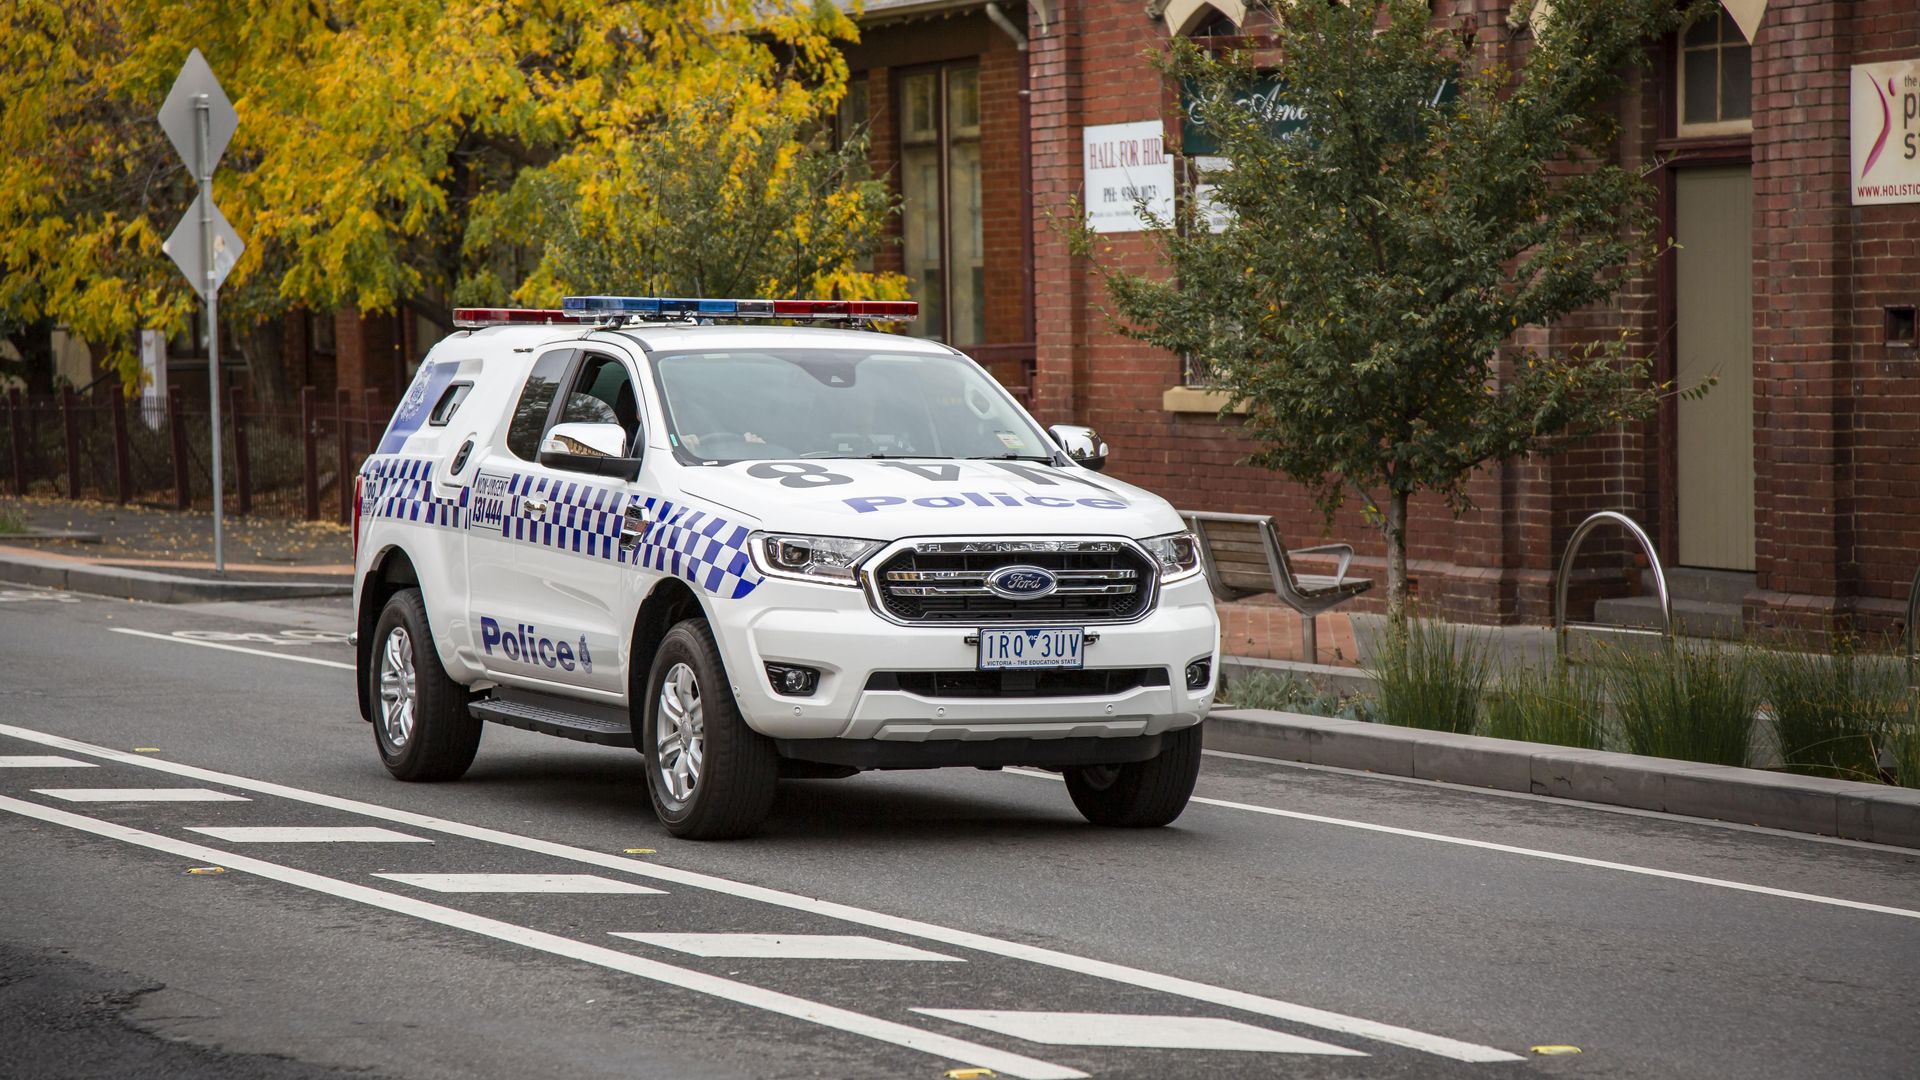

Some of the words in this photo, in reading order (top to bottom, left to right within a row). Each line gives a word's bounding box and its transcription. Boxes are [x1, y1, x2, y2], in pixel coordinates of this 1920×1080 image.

[1904, 92, 1920, 130] p
[1089, 142, 1117, 169] HALL
[1120, 139, 1140, 167] FOR
[1904, 132, 1920, 160] s
[841, 491, 1128, 513] Police
[1007, 573, 1041, 590] Ford
[481, 615, 575, 672] Police
